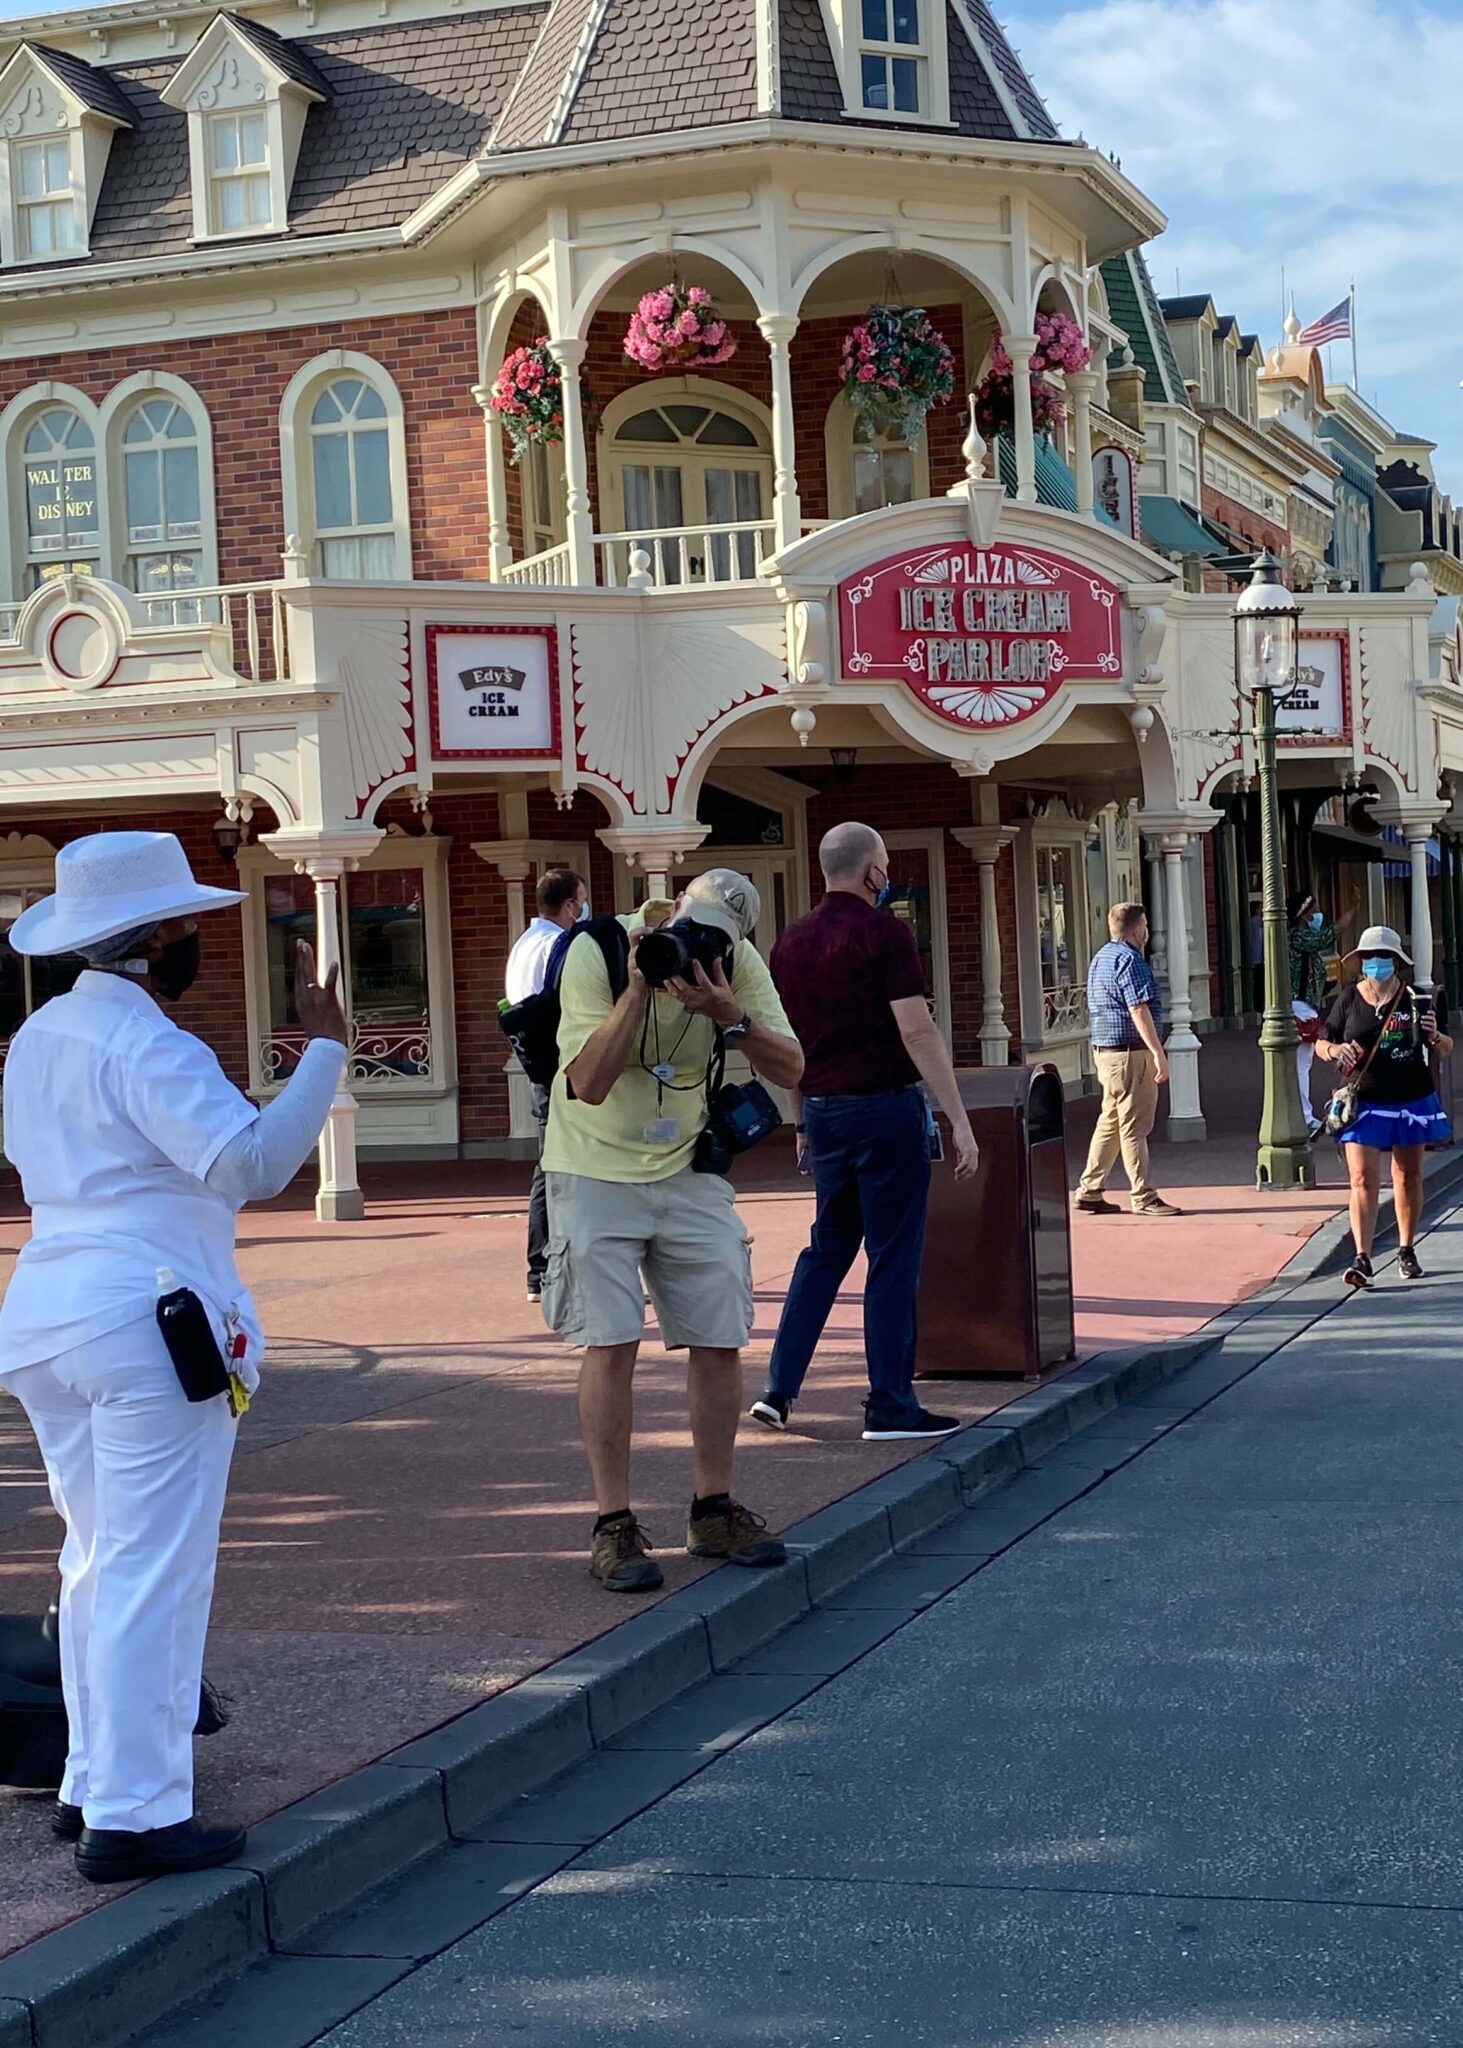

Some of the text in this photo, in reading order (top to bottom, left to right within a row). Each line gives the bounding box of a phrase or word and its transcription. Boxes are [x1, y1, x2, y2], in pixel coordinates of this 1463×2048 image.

[27, 465, 92, 486] WALTER
[38, 500, 94, 521] DISNEY
[950, 552, 1016, 584] PLAZA
[899, 587, 1072, 633] ICE CREAM
[925, 637, 1051, 683] PARLOR
[472, 667, 514, 685] Edy's
[481, 692, 506, 704] ICE
[1281, 700, 1320, 710] CREAM
[468, 705, 520, 717] CREAM
